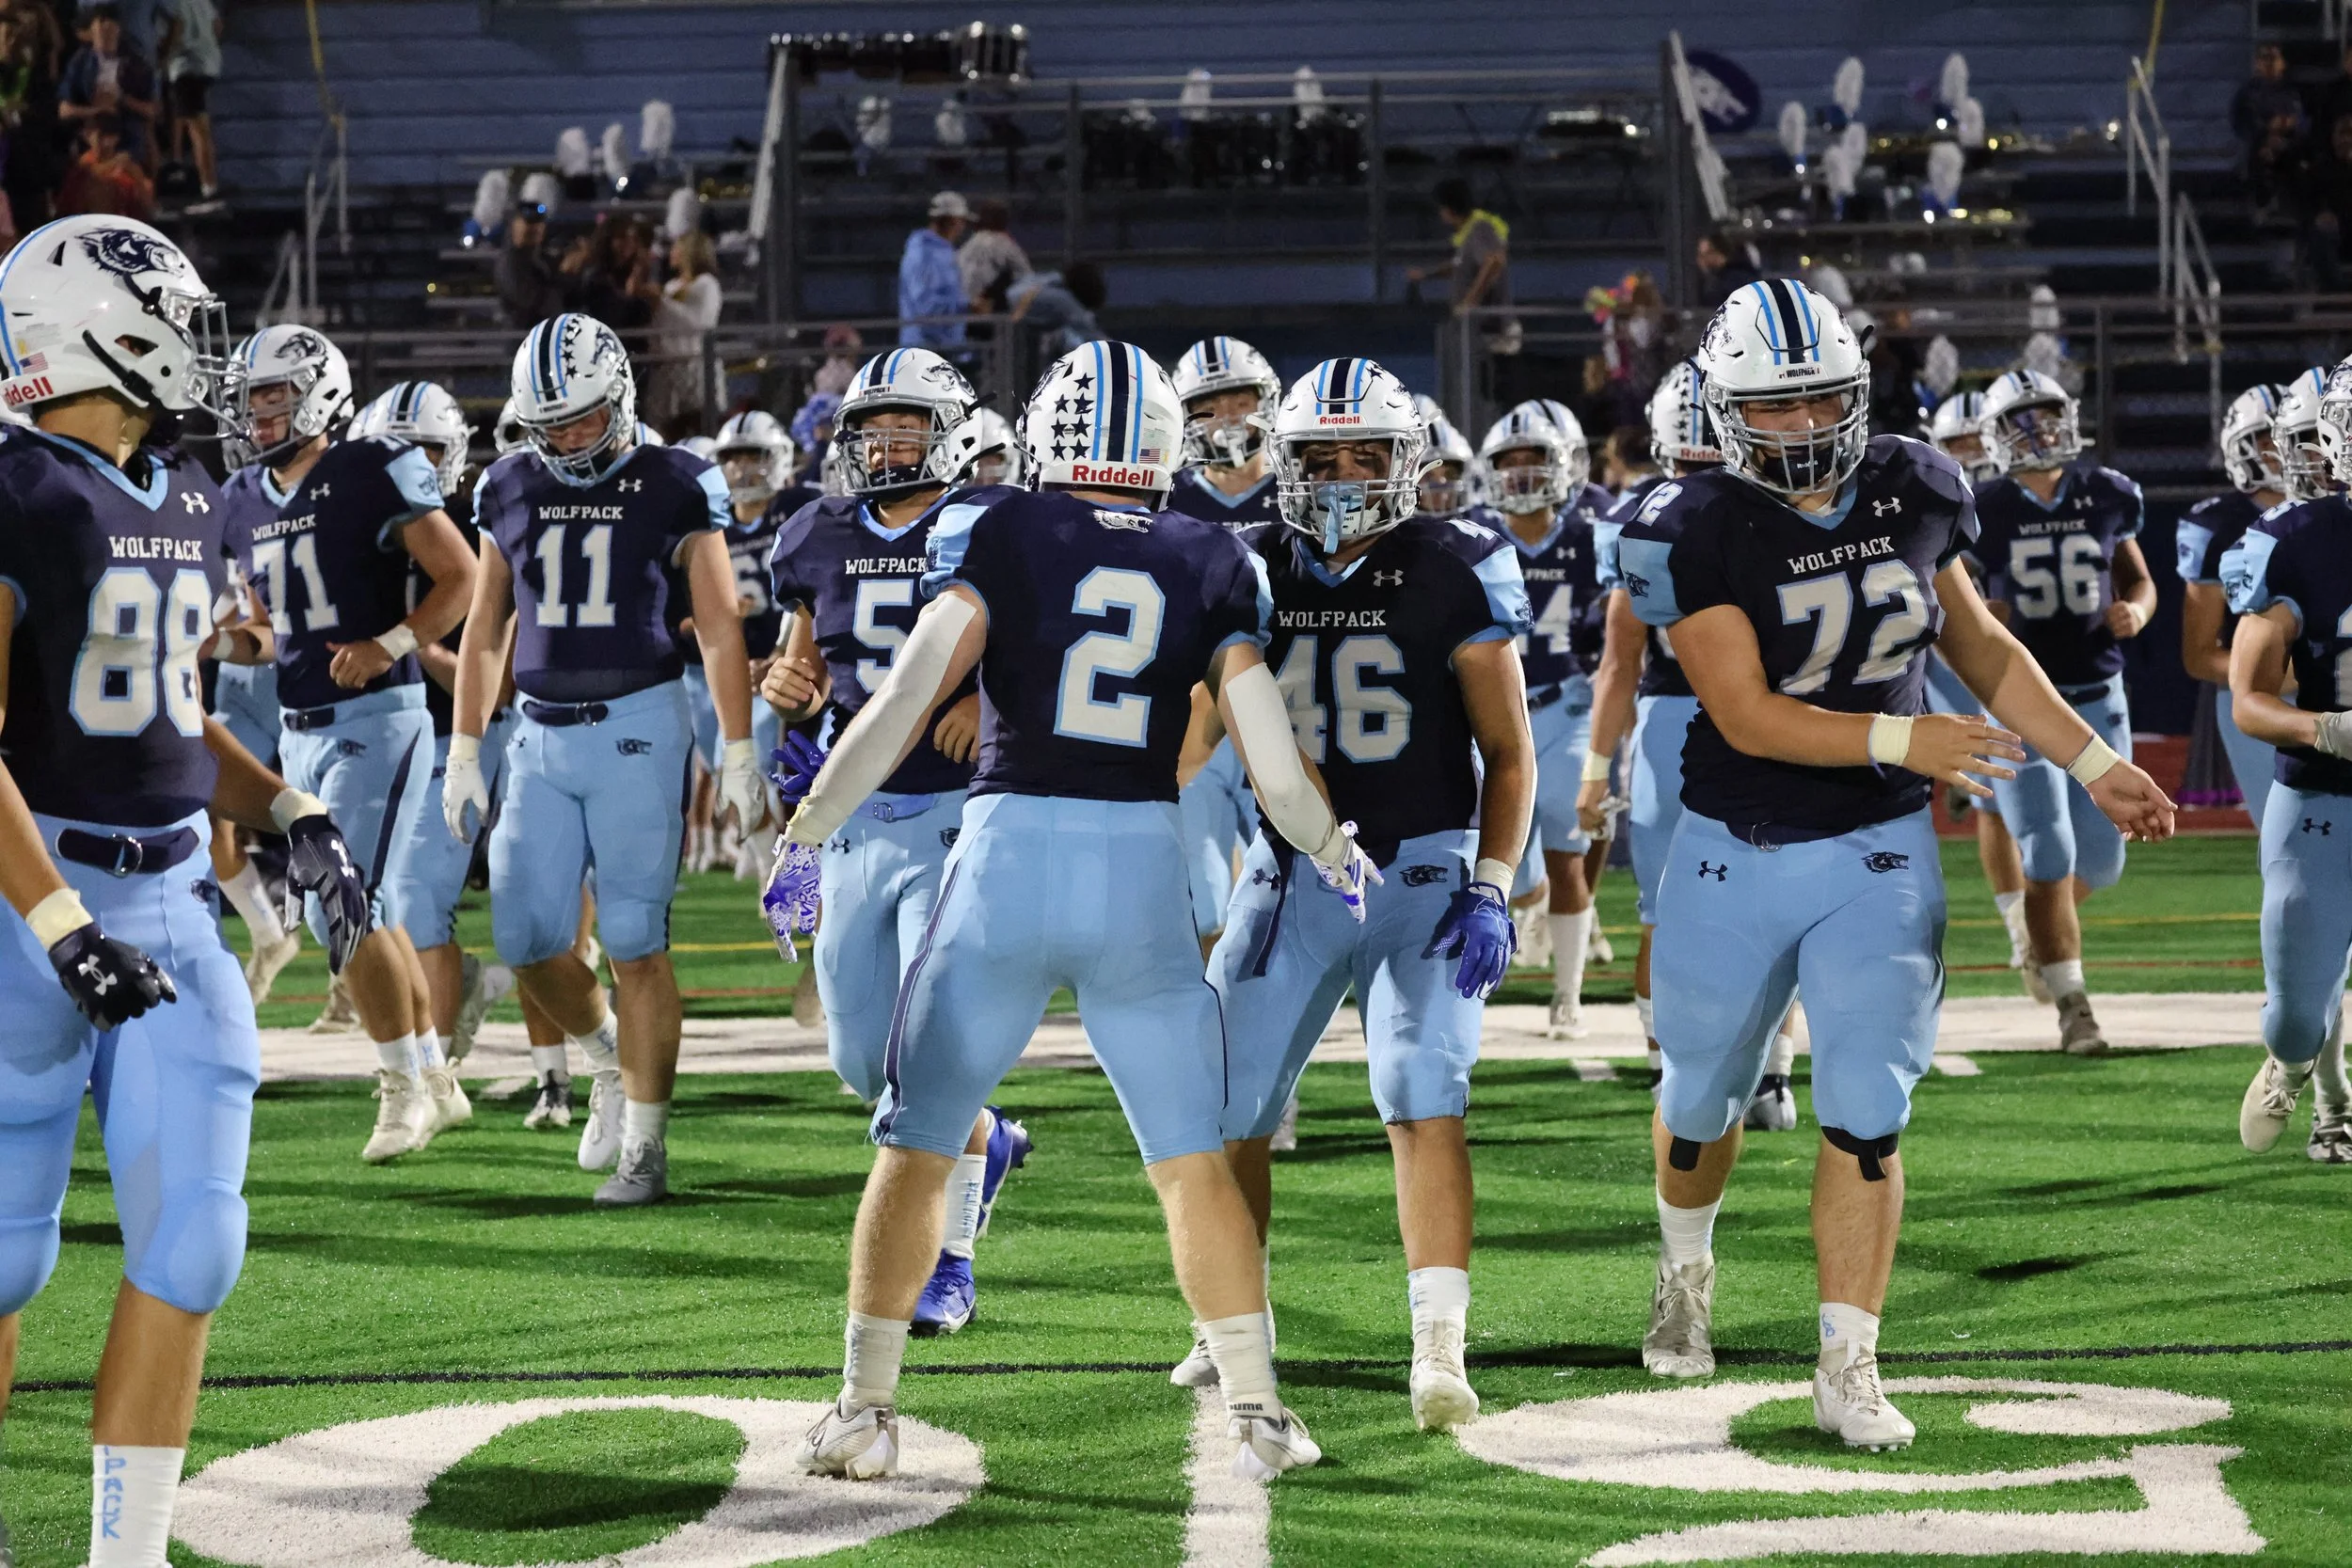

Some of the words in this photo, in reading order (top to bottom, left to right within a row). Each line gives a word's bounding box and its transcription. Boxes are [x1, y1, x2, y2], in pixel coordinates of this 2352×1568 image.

[1319, 416, 1360, 425] Riddell
[1072, 465, 1155, 487] Riddell
[252, 514, 317, 541] WOLFPACK
[538, 505, 624, 520] WOLFPACK
[2018, 516, 2087, 536] WOLFPACK
[109, 536, 203, 562] WOLFPACK
[845, 557, 928, 576] WOLFPACK
[1788, 535, 1896, 576] WOLFPACK
[251, 532, 340, 636] 71
[533, 524, 616, 628] 11
[2009, 534, 2104, 620] 56
[853, 578, 914, 694] 5
[1277, 609, 1386, 628] WOLFPACK
[1775, 559, 1931, 696] 72
[68, 566, 214, 737] 88
[1053, 565, 1167, 749] 2
[1275, 633, 1412, 765] 46
